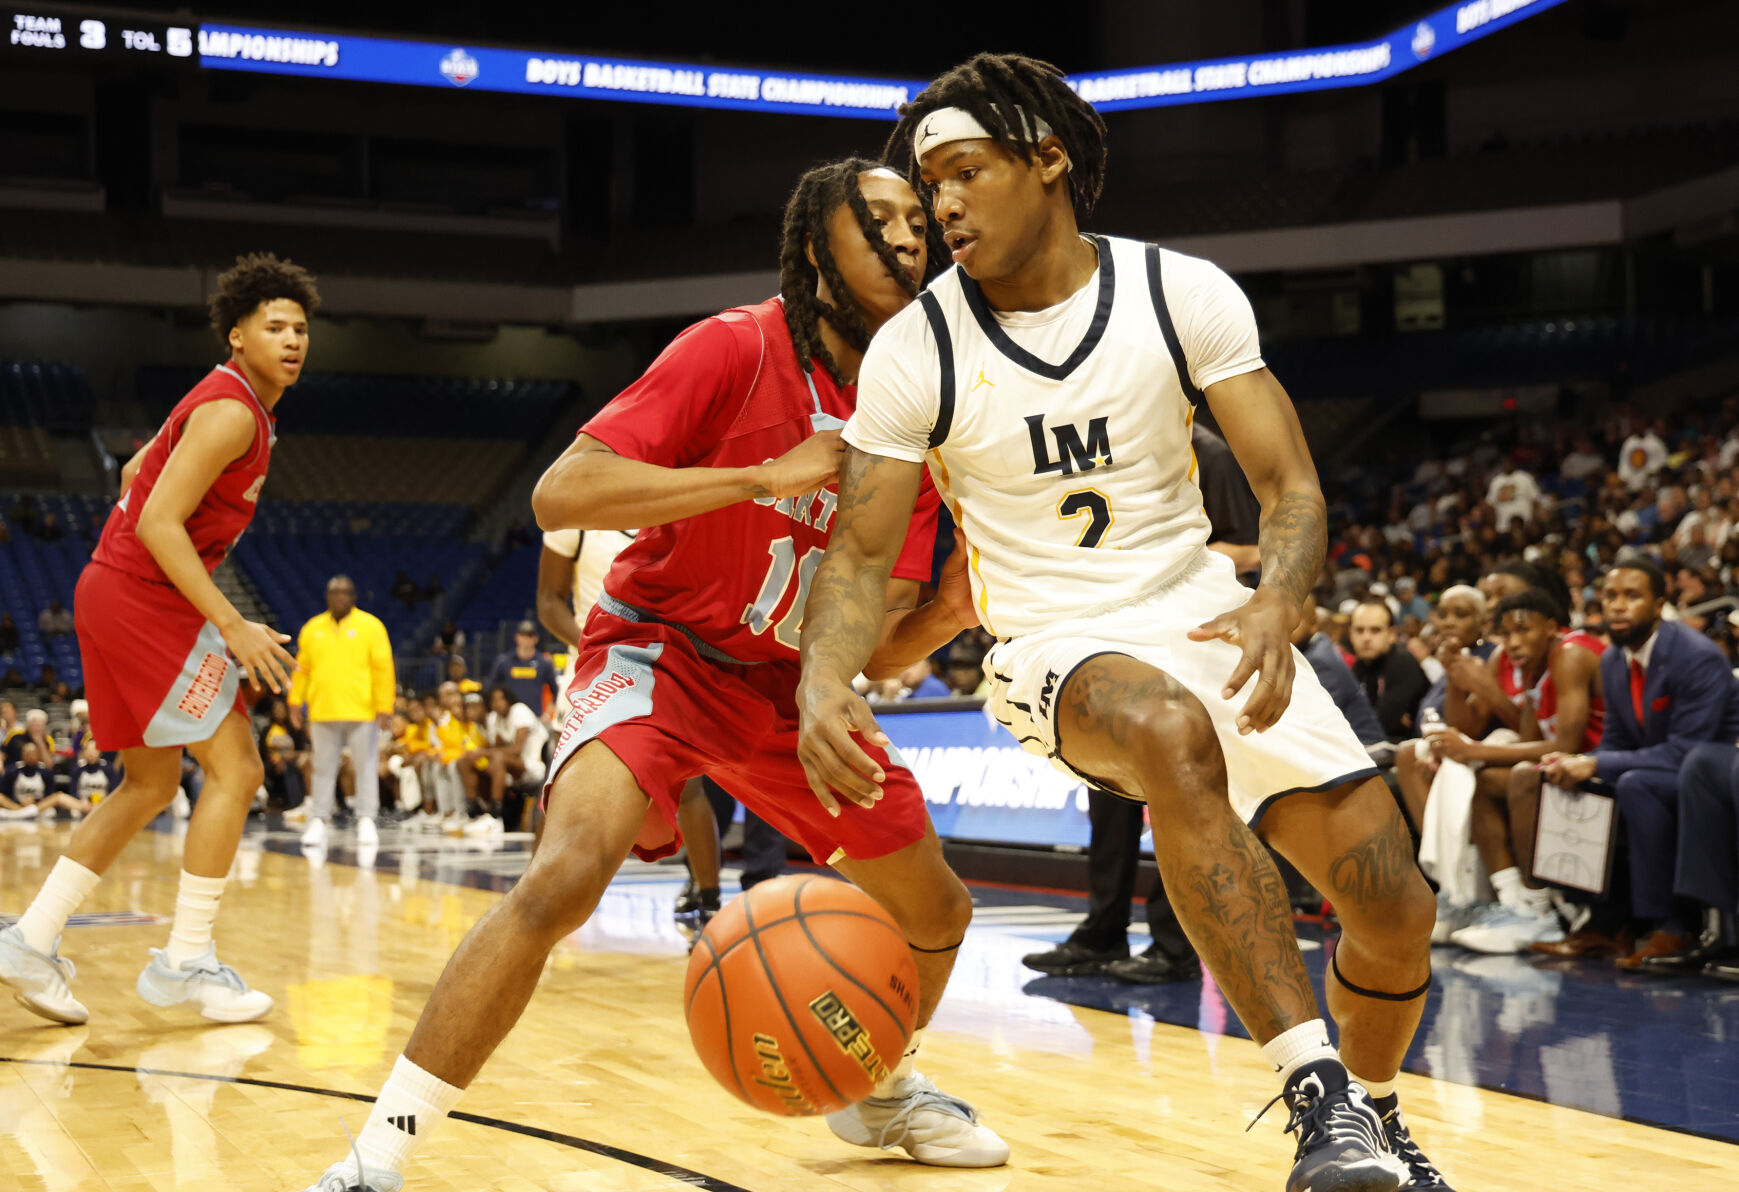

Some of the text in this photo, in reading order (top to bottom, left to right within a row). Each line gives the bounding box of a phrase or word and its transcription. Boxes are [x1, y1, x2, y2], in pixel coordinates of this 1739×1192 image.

[10, 29, 66, 48] FOULS
[13, 14, 61, 33] TEAM
[79, 19, 106, 49] 3
[121, 30, 161, 51] TOL
[166, 27, 192, 57] 5
[526, 58, 581, 86] BOYS
[583, 62, 705, 96] BASKETBALL
[707, 73, 760, 100] STATE
[1078, 42, 1391, 102] BASKETBALL STATE CHAMPIONSHIPS
[1024, 413, 1113, 476] LM
[1056, 486, 1116, 550] 2
[811, 993, 863, 1049] PRO
